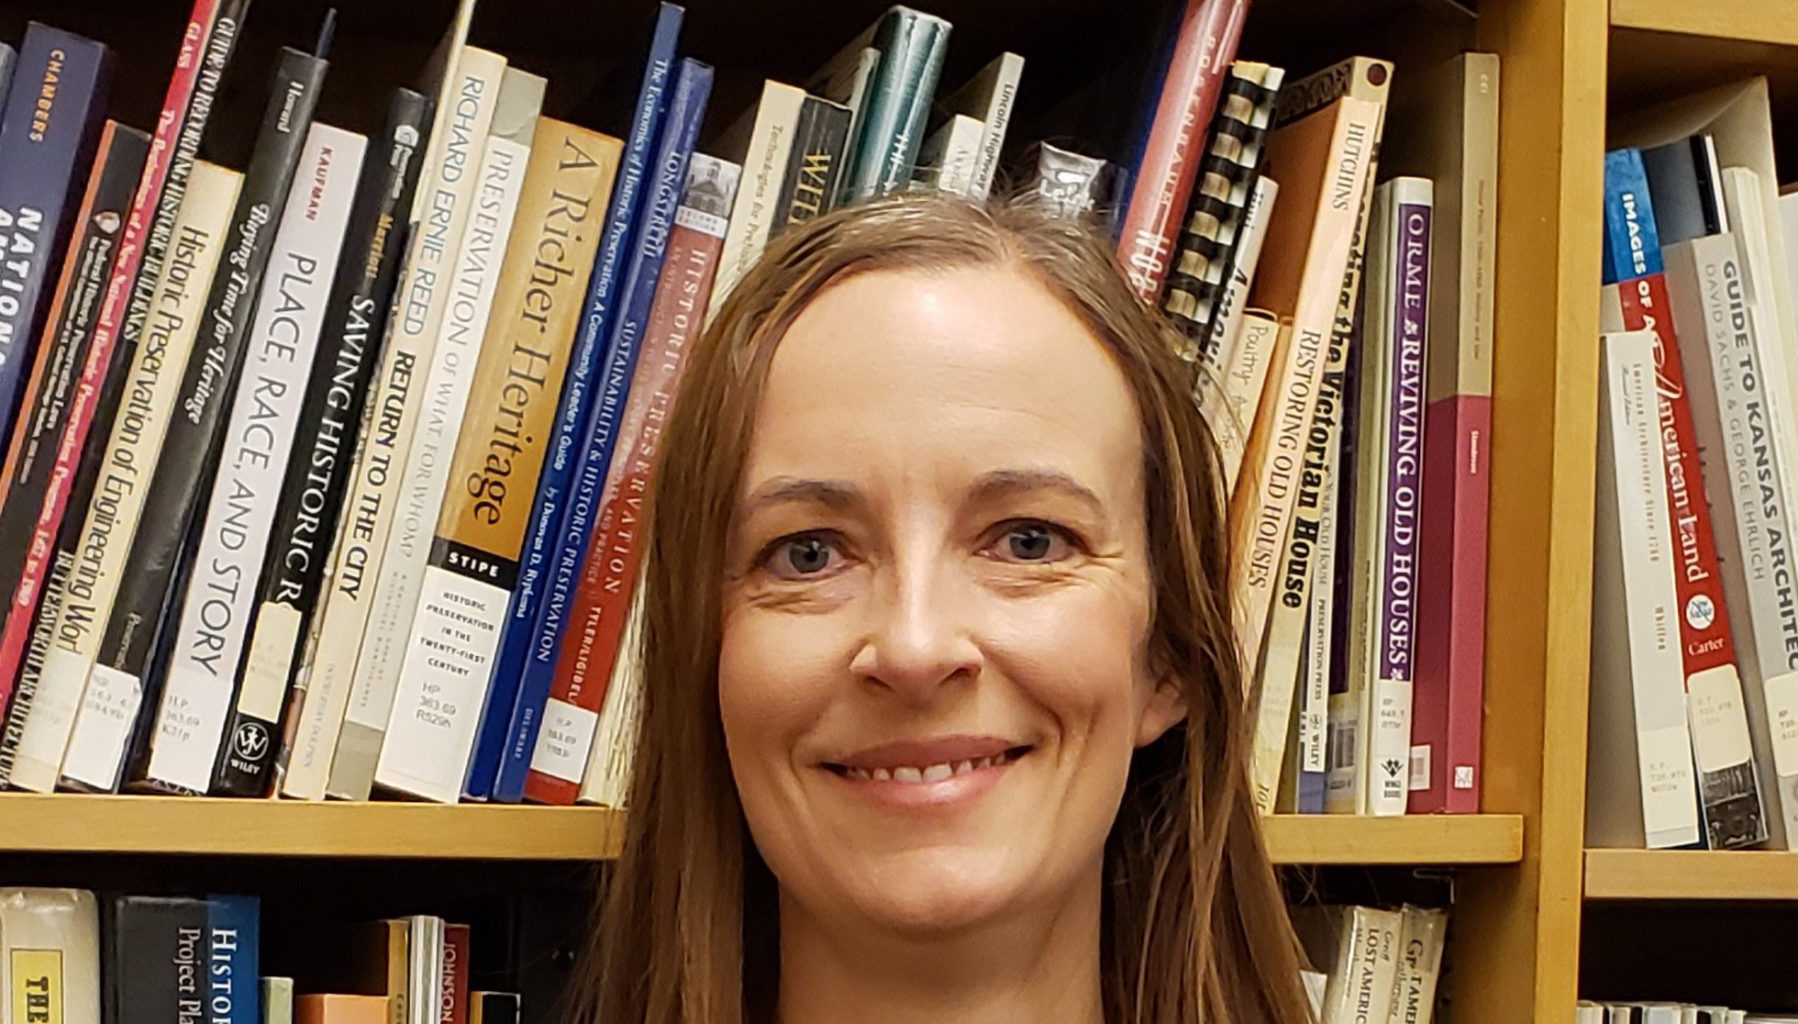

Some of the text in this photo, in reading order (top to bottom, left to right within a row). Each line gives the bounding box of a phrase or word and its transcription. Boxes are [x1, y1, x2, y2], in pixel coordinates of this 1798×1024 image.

[28, 49, 65, 142] CHAMBERS
[198, 68, 222, 93] TO
[205, 16, 237, 70] GUIDE
[170, 90, 215, 184] RECORDING
[276, 80, 305, 134] Howard
[974, 83, 1015, 191] Lincoln Highway
[149, 182, 186, 257] HISTORIC
[304, 146, 334, 221] KAUFMAN
[402, 75, 484, 336] RICHARD ERNIE REED
[597, 58, 669, 299] The Economics of Historic Preservation
[642, 150, 684, 258] LONGSTRETH
[1332, 122, 1366, 211] HUTCHINS
[159, 224, 210, 308] Historic
[1621, 193, 1653, 308] IMAGES OF
[184, 203, 271, 425] Buying Time for Heritage
[399, 149, 514, 559] PRESERVATION OF FOR WHOM?
[468, 135, 599, 526] A Richer Heritage
[659, 249, 708, 377] HISTORIC
[118, 309, 184, 446] Preservation
[553, 300, 606, 471] A Community Leader's Guide
[1651, 334, 1697, 506] American
[1704, 262, 1765, 581] DAVID SACHS & GEORGE EHRLICH
[1722, 259, 1779, 520] GUIDE TO KANSAS
[110, 447, 139, 473] of
[189, 252, 317, 677] PLACE, RACE, AND STORY
[284, 294, 376, 572] SAVING HISTORIC
[338, 349, 417, 601] RETURN TO THE CITY
[1247, 329, 1322, 589] RESTORING OLD HOUSES
[1281, 316, 1355, 609] the Victorian House
[1388, 213, 1425, 665] ORME REVIVING OLD HOUSES
[66, 473, 134, 601] Engineering
[533, 501, 556, 551] Donovan
[536, 320, 638, 663] SUSTAINABILITY & HISTORIC PRESERVATION
[604, 389, 671, 594] PRESERVATION
[447, 551, 500, 577] STIPE
[528, 552, 542, 566] D.
[1677, 514, 1709, 582] Land
[420, 637, 486, 664] TWENTY-FIRST
[427, 657, 470, 677] CENTURY
[454, 631, 472, 642] THE
[1310, 598, 1326, 765] PRESERVATION PRESS WILEY
[1688, 637, 1725, 656] Carter
[230, 759, 262, 775] WILEY
[26, 976, 49, 1023] THE
[174, 927, 201, 992] Project
[437, 943, 457, 1022] JOHNSON
[1364, 927, 1381, 966] LOST
